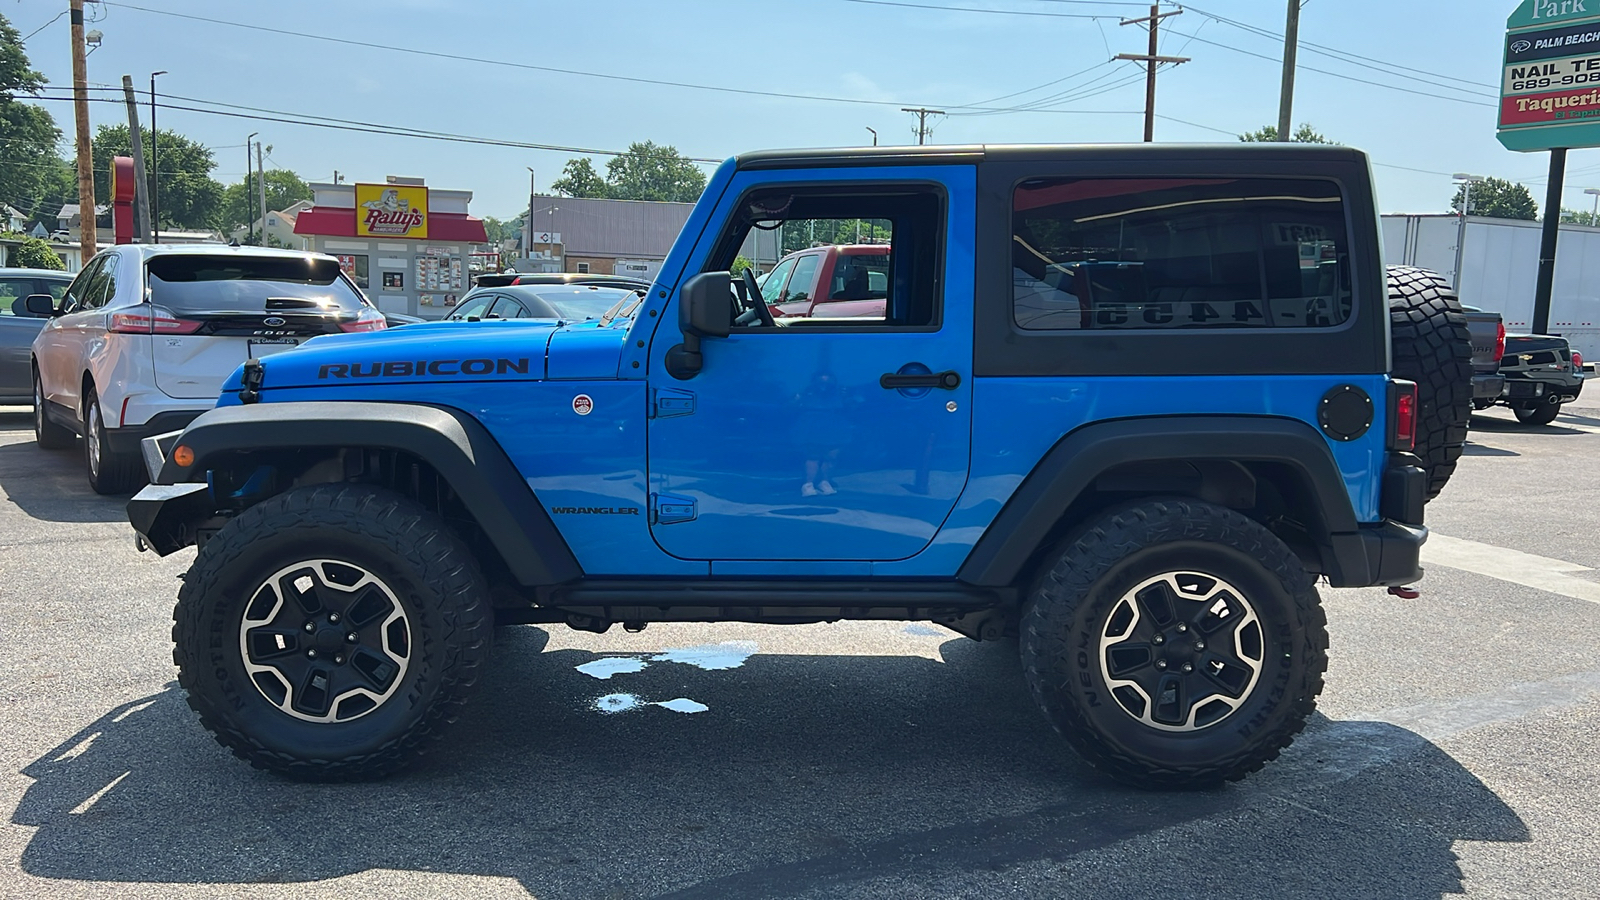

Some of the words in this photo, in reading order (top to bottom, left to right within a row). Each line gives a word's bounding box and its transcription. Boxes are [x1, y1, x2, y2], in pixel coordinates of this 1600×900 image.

[1531, 0, 1587, 19] Park
[1535, 37, 1563, 49] PALM
[1565, 32, 1600, 45] BEACH
[1512, 64, 1560, 79] NAIL
[1571, 58, 1600, 72] TE
[1513, 73, 1600, 90] 689-908
[363, 207, 423, 233] Rally's
[317, 358, 530, 379] RUBICON
[551, 507, 639, 515] WRANGLER
